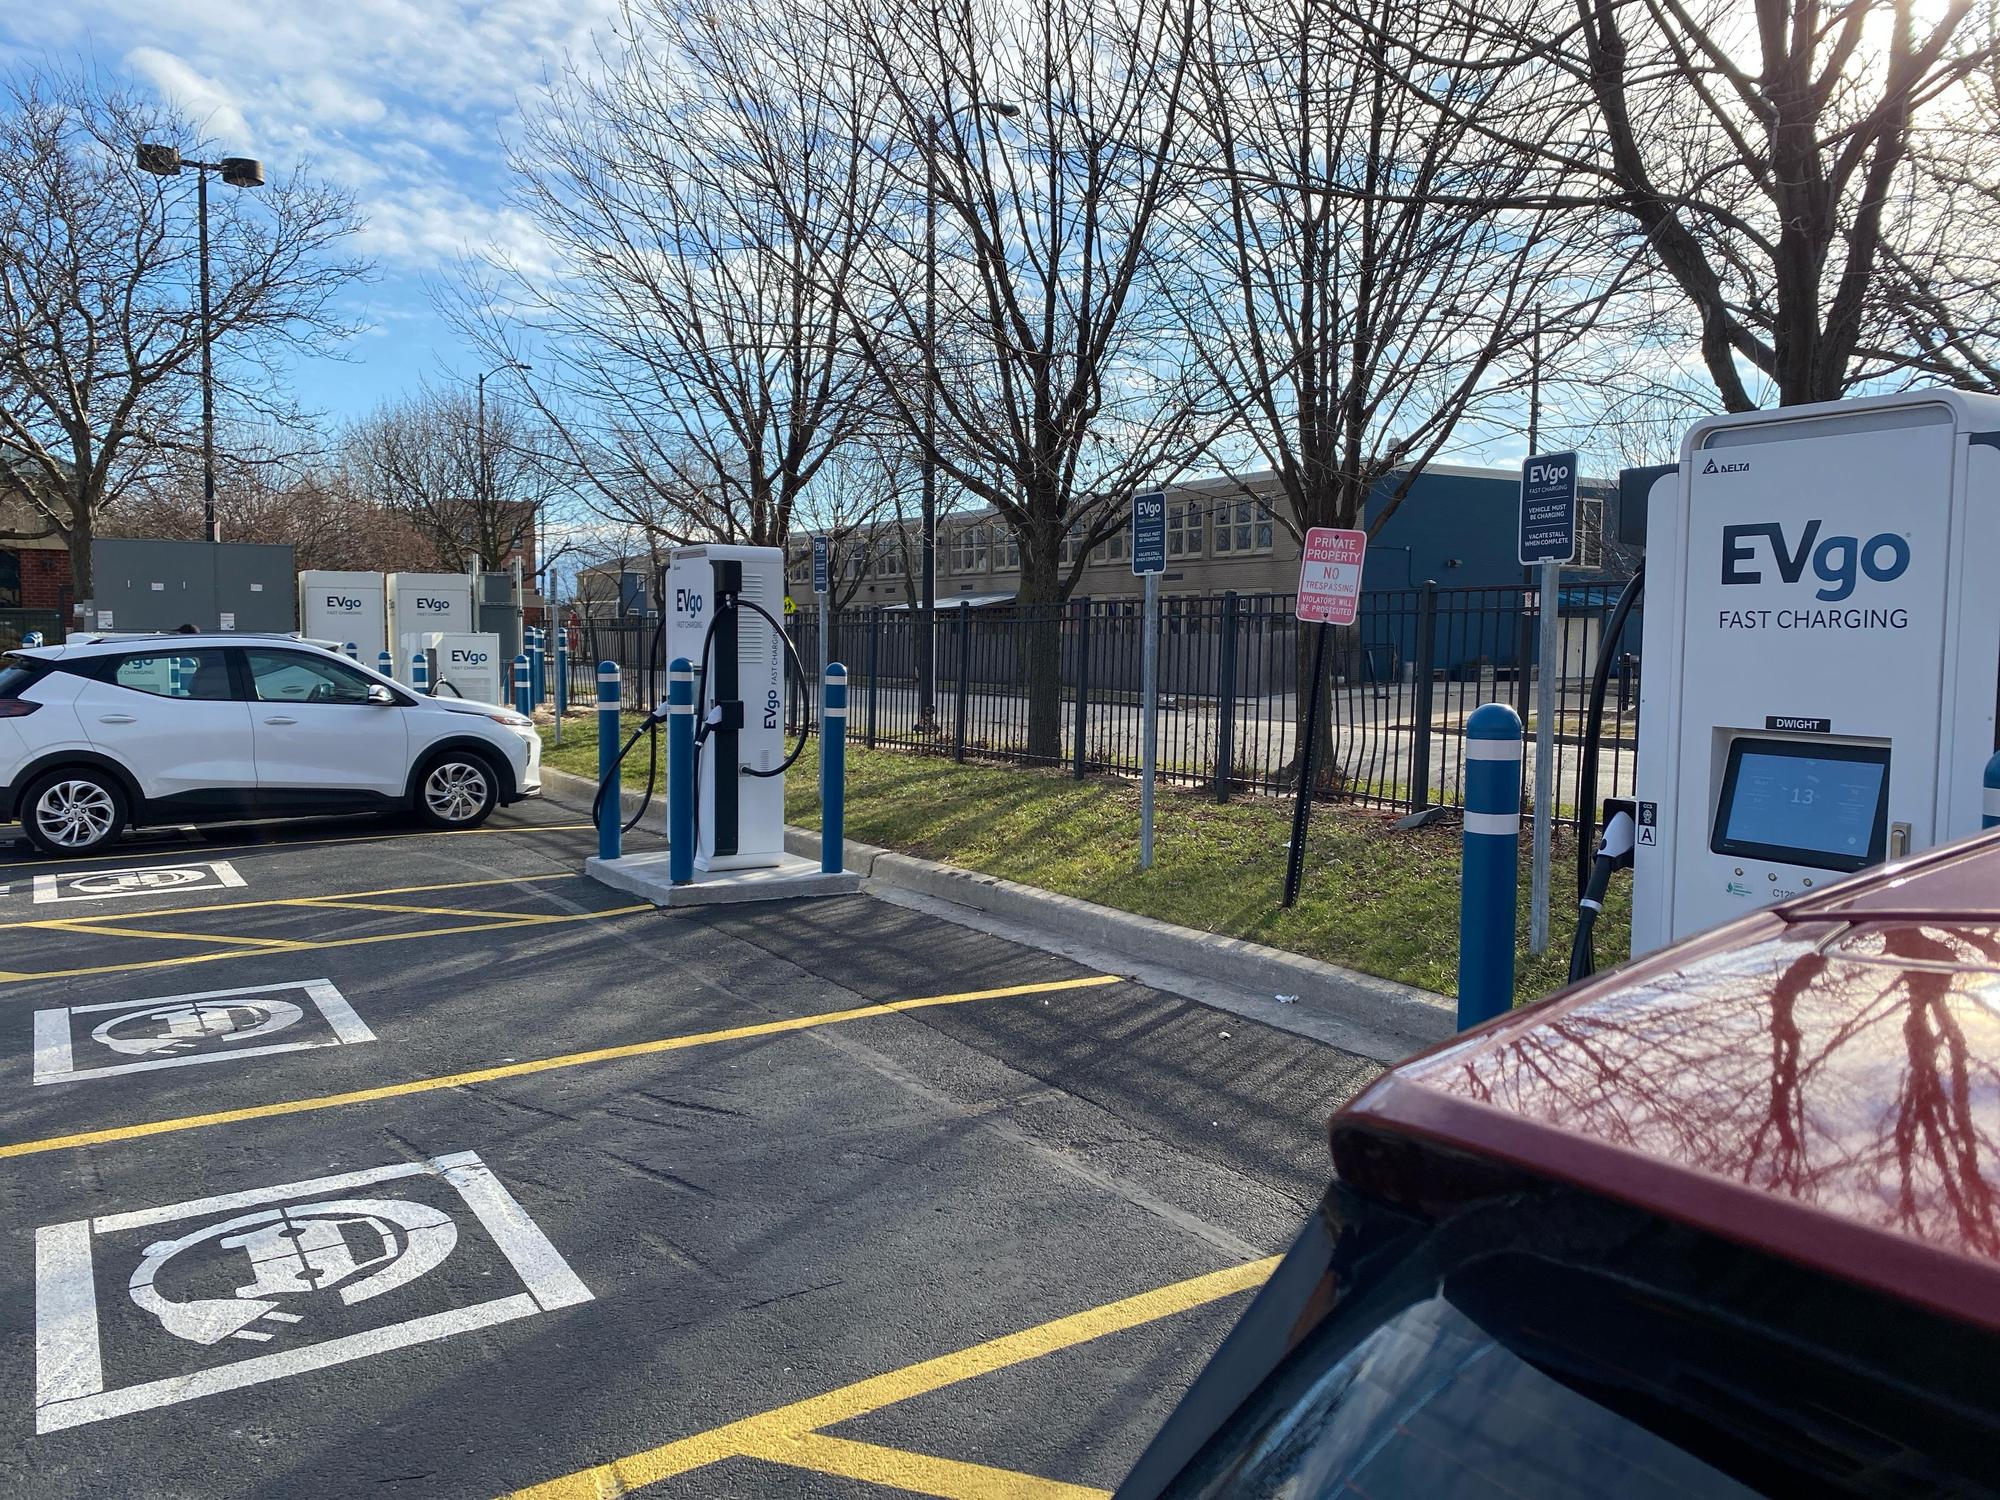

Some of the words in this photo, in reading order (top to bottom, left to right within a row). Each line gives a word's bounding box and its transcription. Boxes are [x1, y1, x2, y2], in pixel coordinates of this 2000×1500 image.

[1530, 464, 1568, 485] EVgo
[1721, 463, 1750, 473] DELTA
[1137, 502, 1160, 517] EVgo
[1528, 506, 1551, 514] VEHICLE
[1551, 503, 1567, 511] MUST
[1537, 511, 1565, 519] CHARGING
[1528, 532, 1549, 540] VACATE
[1540, 537, 1569, 545] COMPLETE
[1314, 537, 1357, 550] PRIVATE
[1306, 549, 1361, 562] PROPERTY
[1721, 519, 1911, 602] EVgo
[1323, 566, 1340, 580] NO
[1306, 580, 1354, 593] TRESPASSING
[326, 596, 362, 611] EVgo
[416, 598, 450, 612] EVgo
[676, 588, 703, 619] EVgo
[1302, 594, 1337, 605] VIOLATORS
[1338, 599, 1353, 607] WILL
[1300, 603, 1310, 612] BE
[1311, 605, 1352, 616] PROSECUTED
[1719, 610, 1772, 629] FAST
[1777, 608, 1908, 629] CHARGING
[451, 649, 488, 665] EVgo
[770, 666, 778, 685] FAST
[763, 689, 781, 730] EVgo
[1776, 718, 1820, 730] DWIGHT
[1791, 788, 1814, 805] 13
[1641, 827, 1653, 843] A
